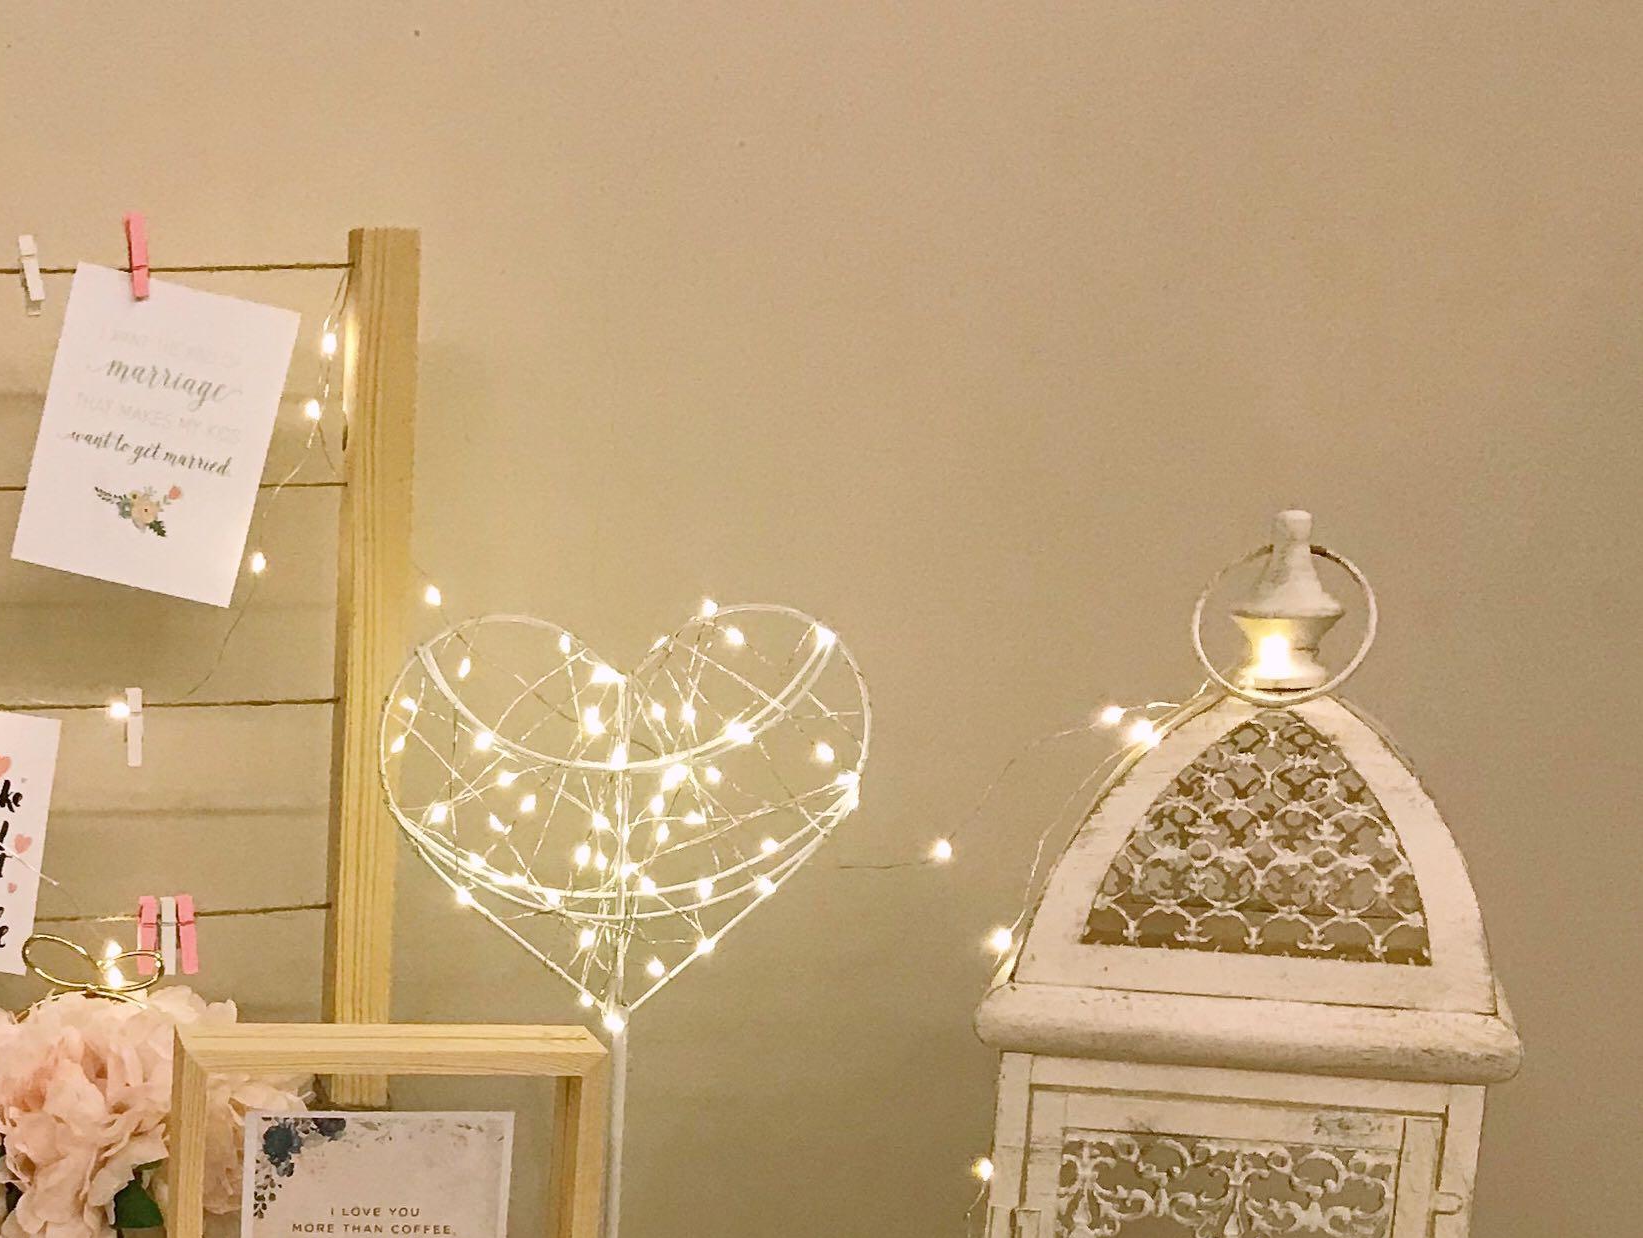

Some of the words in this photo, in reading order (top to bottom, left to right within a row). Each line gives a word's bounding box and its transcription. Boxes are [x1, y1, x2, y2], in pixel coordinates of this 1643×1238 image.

[86, 357, 244, 412] marriage
[61, 430, 115, 450] want
[127, 440, 161, 466] get
[162, 451, 233, 476] married
[341, 1206, 382, 1218] LOVE
[389, 1206, 421, 1218] YOU
[292, 1222, 335, 1235] MORE
[343, 1222, 384, 1236] THAN
